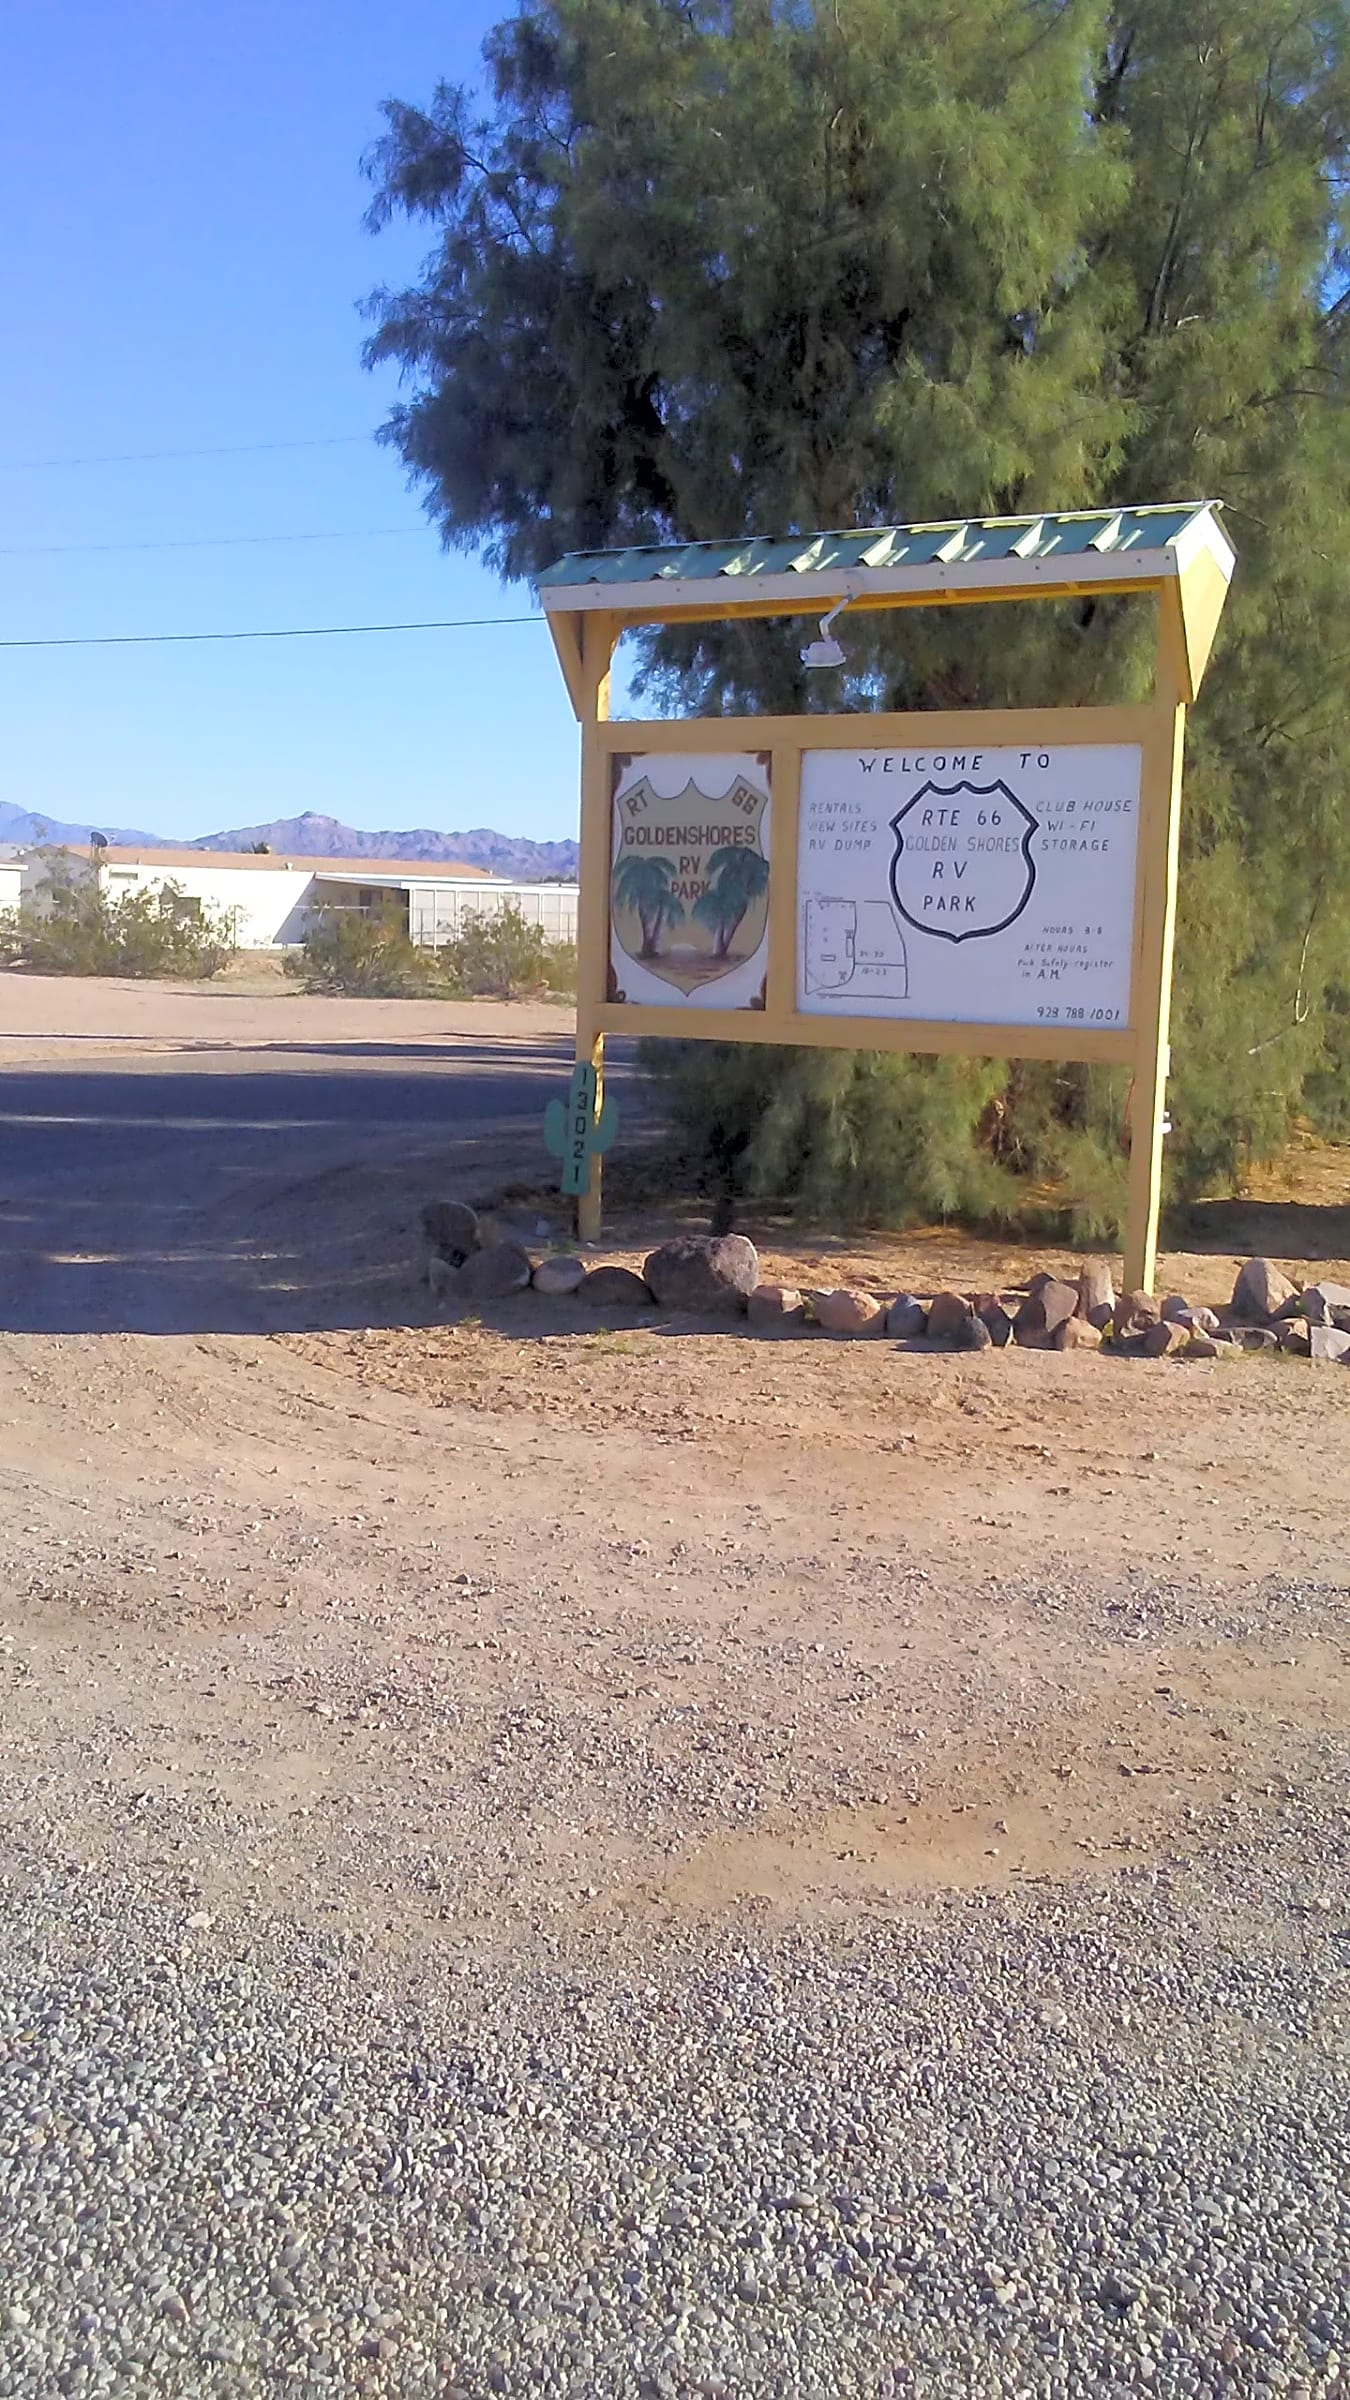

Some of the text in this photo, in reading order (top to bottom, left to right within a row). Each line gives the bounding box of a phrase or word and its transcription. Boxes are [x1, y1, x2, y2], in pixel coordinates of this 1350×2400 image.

[858, 753, 1050, 773] WELCOME TO
[625, 785, 758, 817] RT 66
[809, 802, 861, 814] RENTALS
[1036, 800, 1132, 813] CLUB HOUSE
[921, 809, 1001, 826] RTE 66
[808, 821, 877, 832] VIEW SITES
[624, 825, 756, 846] GOLDENSHORES
[809, 839, 871, 851] RV DUMP
[905, 836, 1020, 852] GOLDEN SHORES
[1041, 839, 1109, 851] STORAGE
[679, 856, 701, 875] RV
[671, 881, 711, 900] PARK
[923, 895, 976, 912] PARK
[1042, 926, 1073, 935] HOURS
[1057, 944, 1088, 954] HOURS
[1074, 959, 1113, 971] register
[1036, 1006, 1120, 1020] 928 788 1001
[573, 1067, 588, 1184] 13021
